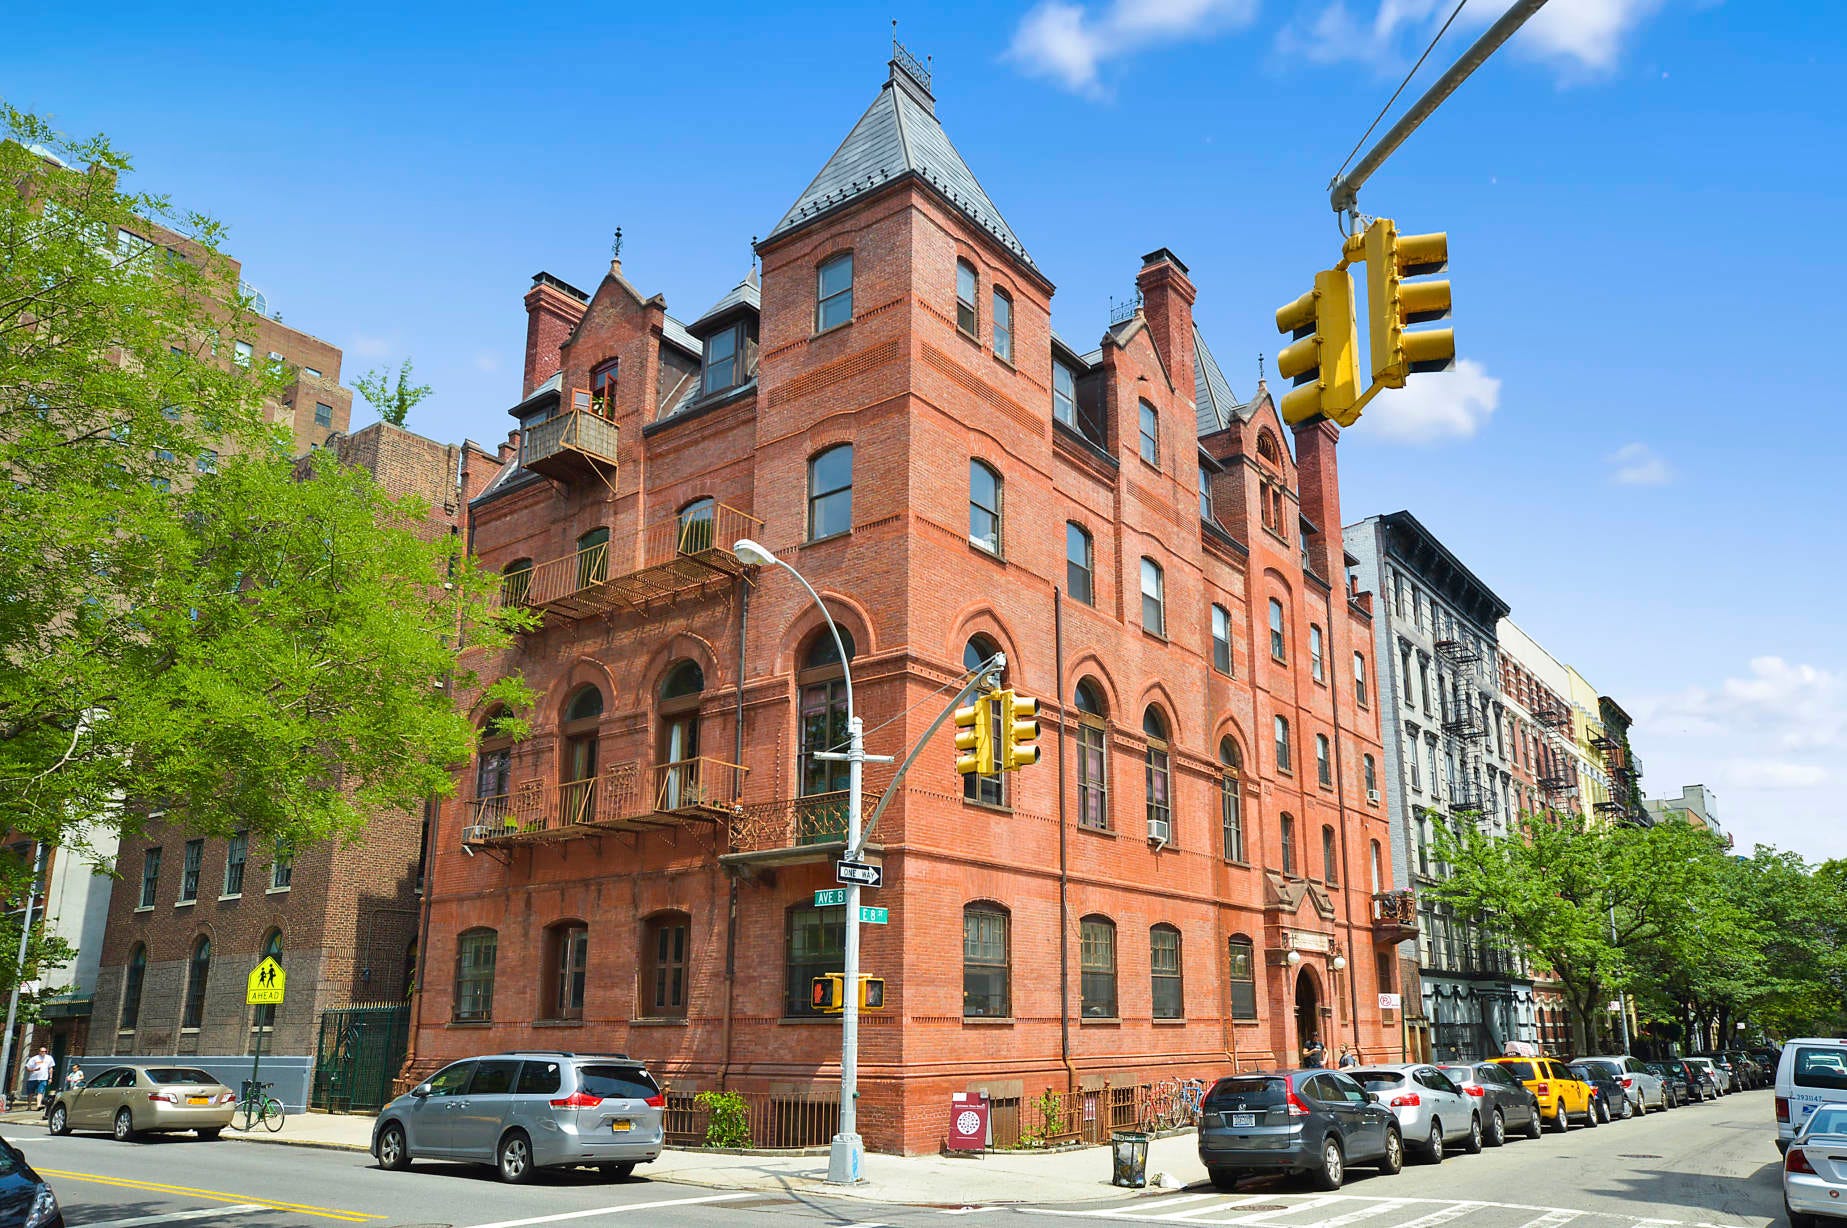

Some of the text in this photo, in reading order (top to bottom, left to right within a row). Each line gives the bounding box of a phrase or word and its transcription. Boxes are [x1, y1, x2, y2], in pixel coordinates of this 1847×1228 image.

[843, 868, 875, 879] ONE WAY
[818, 891, 833, 903] AVE
[863, 909, 868, 920] E
[870, 909, 876, 921] 8
[251, 991, 280, 1000] AHEAD
